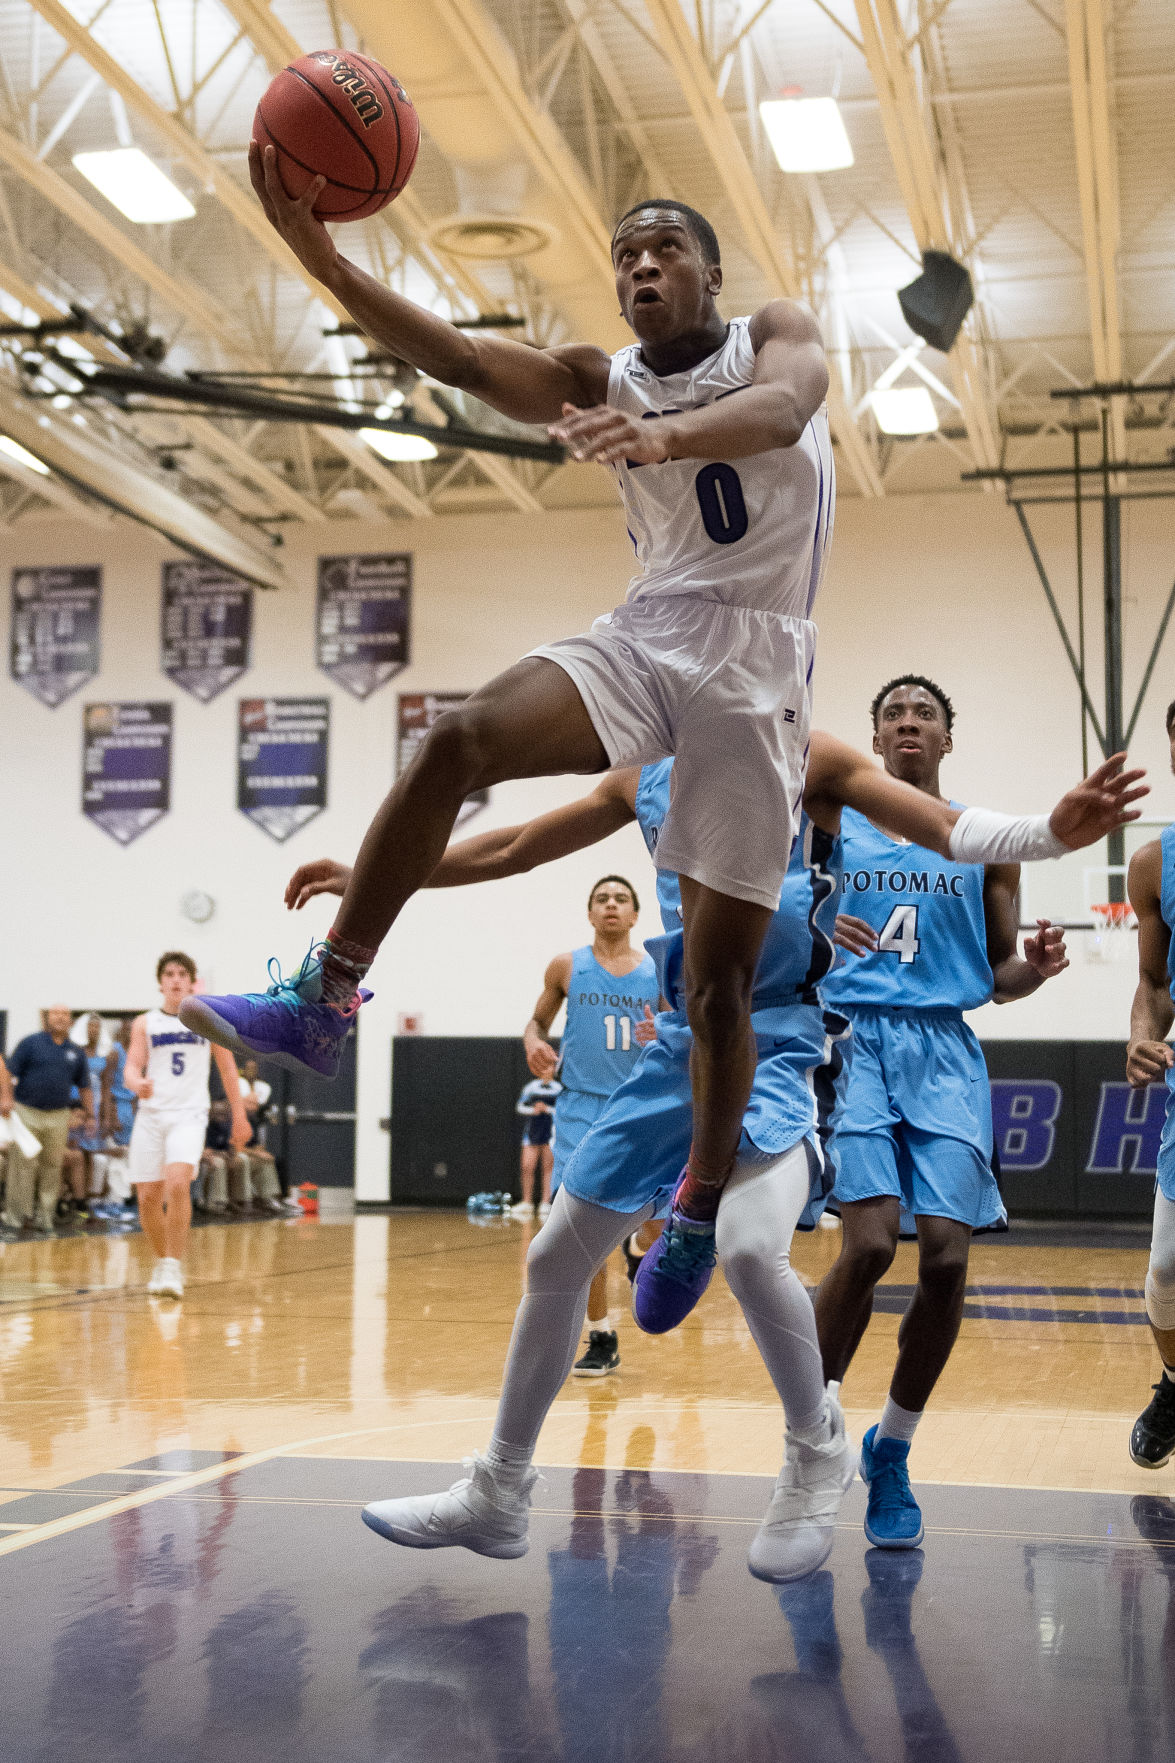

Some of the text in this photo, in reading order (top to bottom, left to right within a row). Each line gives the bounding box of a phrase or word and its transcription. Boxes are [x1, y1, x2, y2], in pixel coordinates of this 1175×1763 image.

[695, 462, 749, 545] 0
[842, 869, 965, 898] POTOMAC
[877, 903, 921, 965] 4
[579, 992, 650, 1010] POTOMA
[603, 1014, 631, 1051] 11
[172, 1052, 185, 1077] 5
